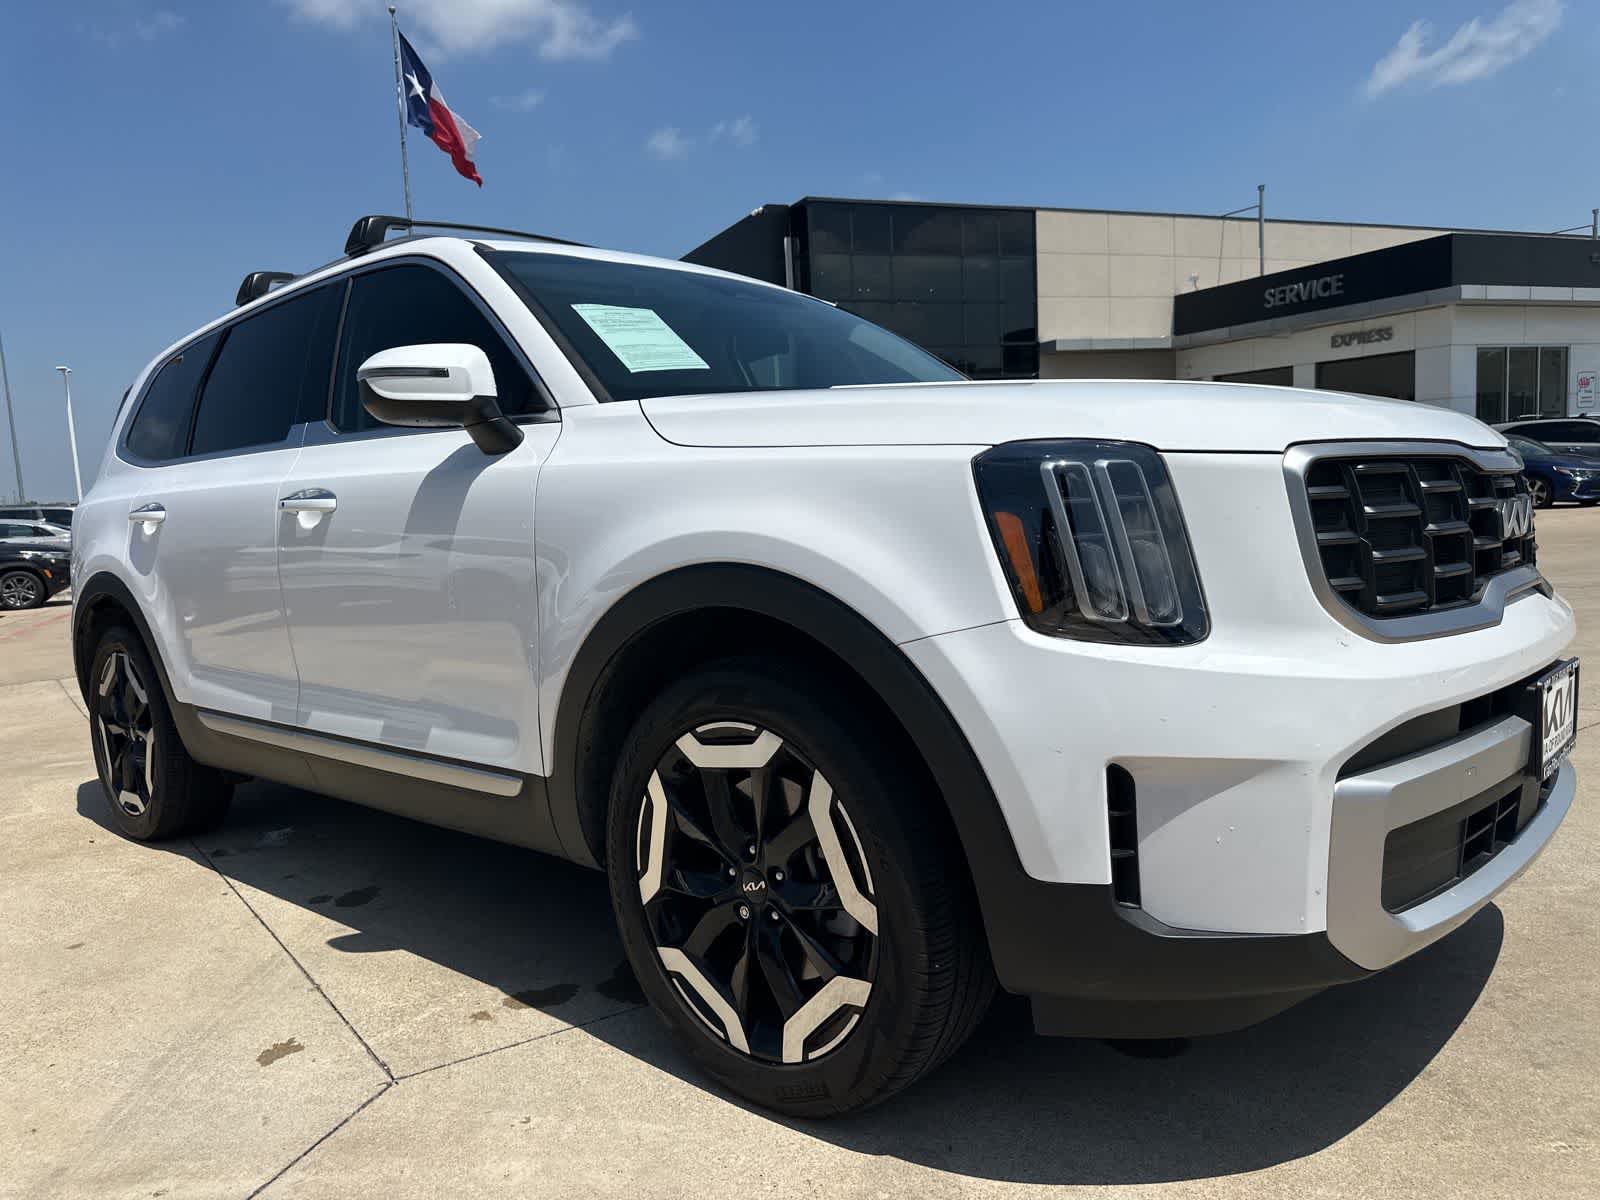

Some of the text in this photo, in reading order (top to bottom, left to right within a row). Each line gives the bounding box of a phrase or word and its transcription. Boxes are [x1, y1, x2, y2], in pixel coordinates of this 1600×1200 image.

[1264, 274, 1344, 308] SERVICE
[1330, 327, 1393, 348] EXPRESS
[1543, 680, 1573, 740] KIA
[742, 880, 766, 892] KIA
